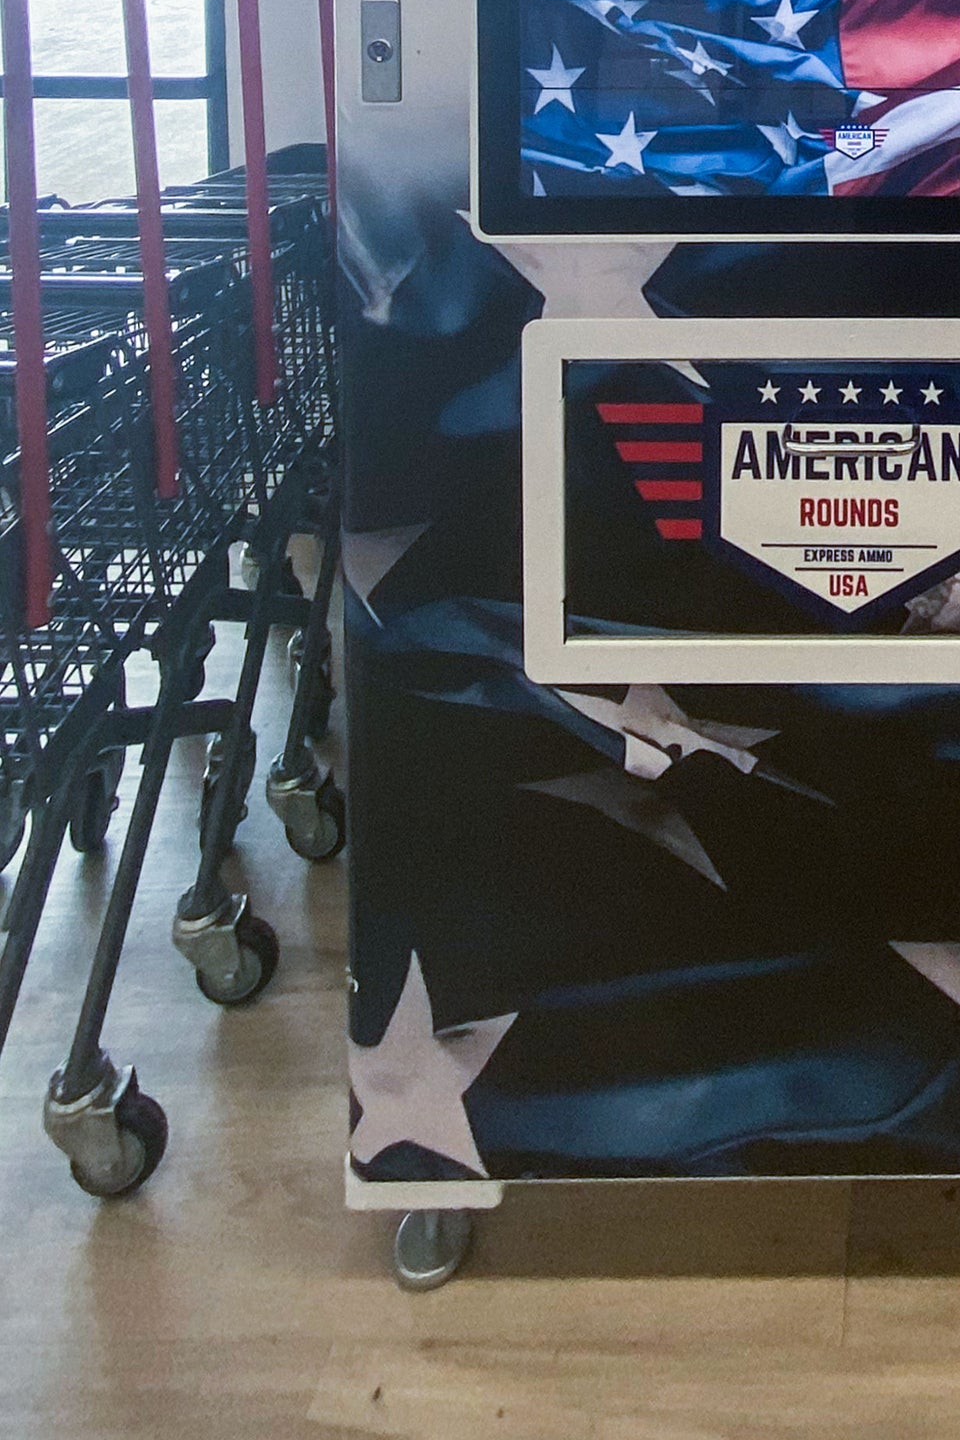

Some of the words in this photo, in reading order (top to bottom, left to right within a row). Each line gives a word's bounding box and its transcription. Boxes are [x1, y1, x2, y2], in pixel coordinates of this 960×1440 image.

[800, 498, 899, 527] ROUNDS
[804, 549, 855, 562] EXPRESS
[858, 550, 893, 563] AMMO
[829, 574, 869, 597] USA
